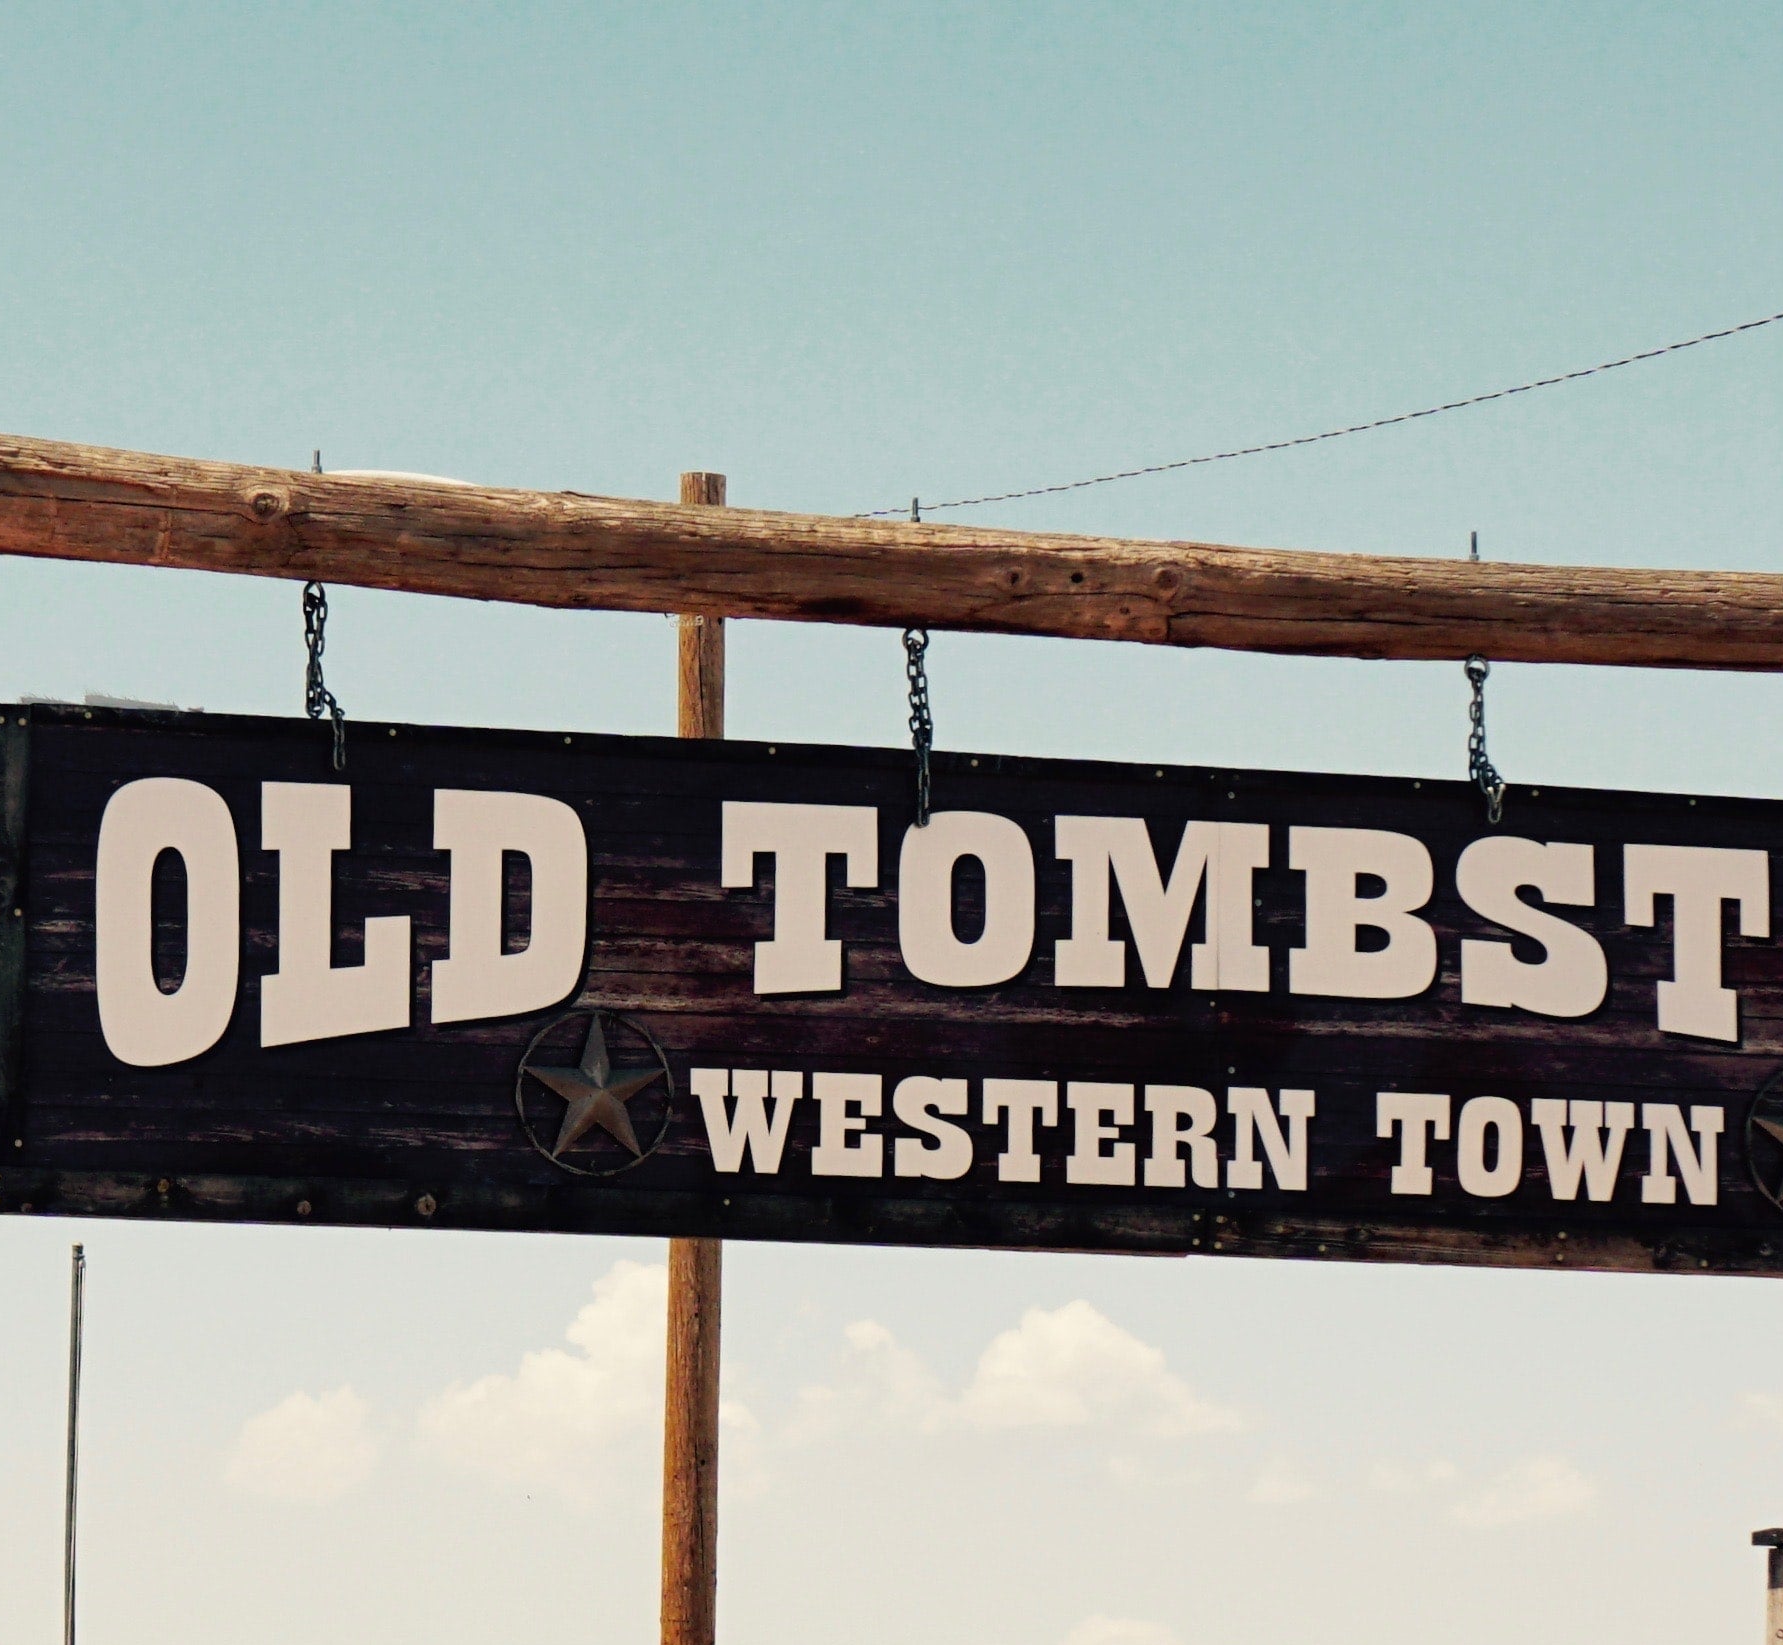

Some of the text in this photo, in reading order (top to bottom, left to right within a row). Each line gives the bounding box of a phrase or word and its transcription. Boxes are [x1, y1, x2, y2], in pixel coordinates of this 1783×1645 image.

[96, 778, 587, 1066] OLD
[691, 1069, 1723, 1204] WESTERN TOWN
